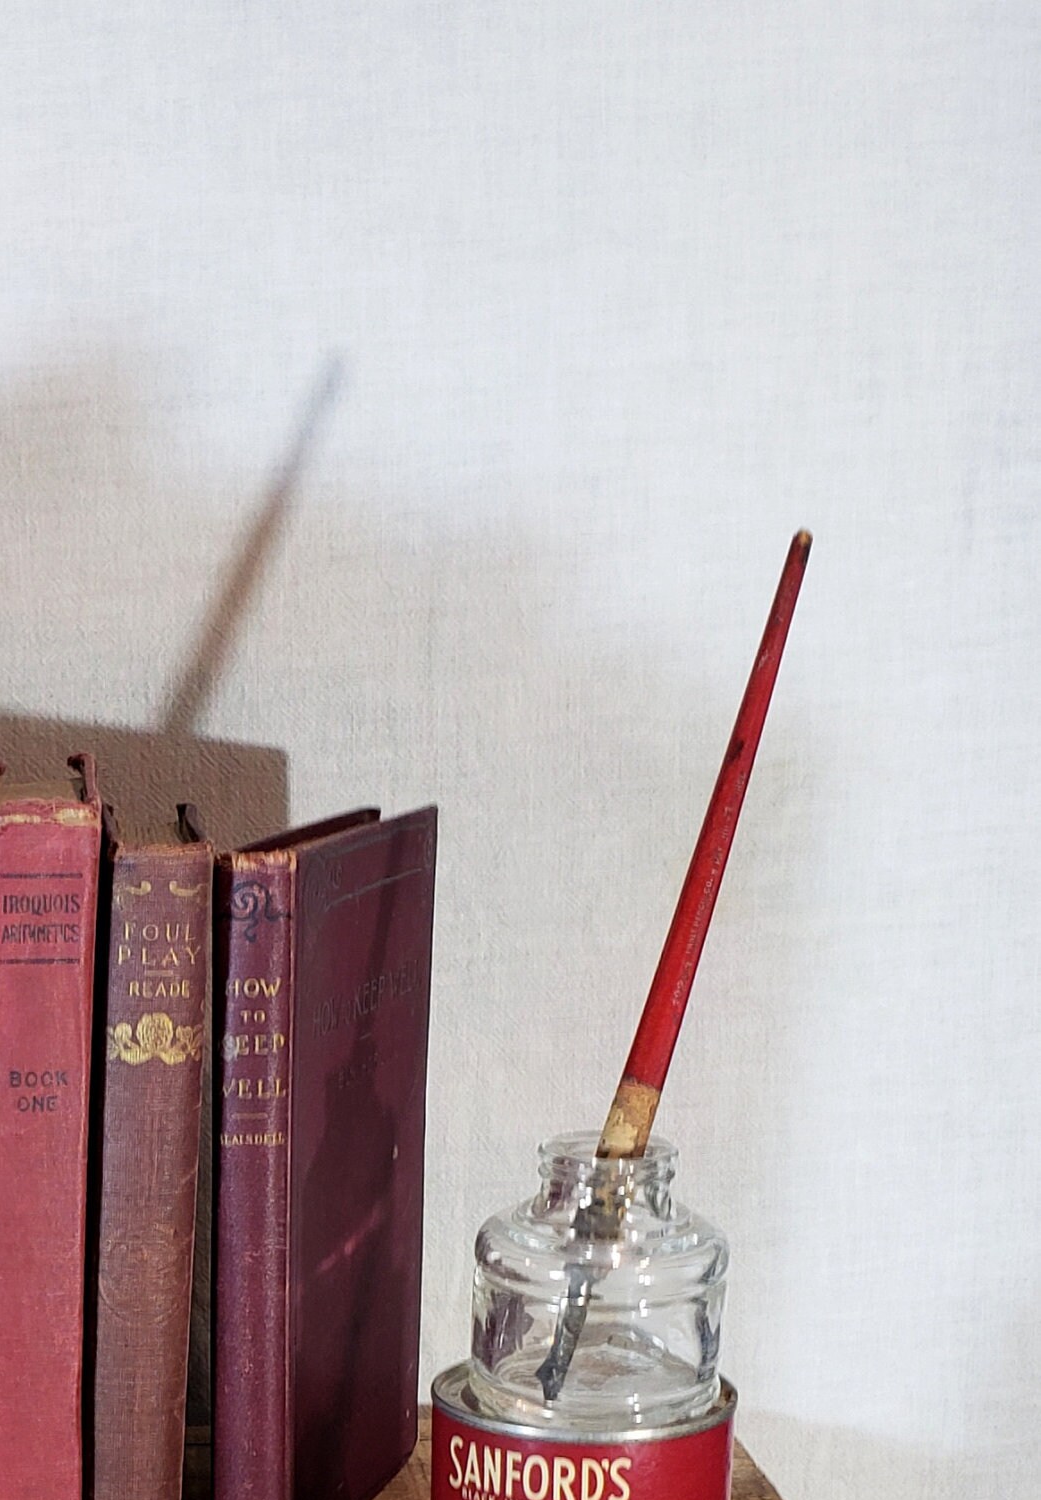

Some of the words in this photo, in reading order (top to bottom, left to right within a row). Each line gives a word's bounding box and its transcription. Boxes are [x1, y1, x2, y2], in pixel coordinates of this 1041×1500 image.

[2, 894, 81, 915] IROQUOIS
[123, 921, 196, 942] FOUL
[117, 945, 202, 967] PLAY
[239, 1009, 266, 1024] TO
[223, 1033, 286, 1056] EEP
[9, 1070, 68, 1089] BOOK
[16, 1095, 59, 1113] ONE
